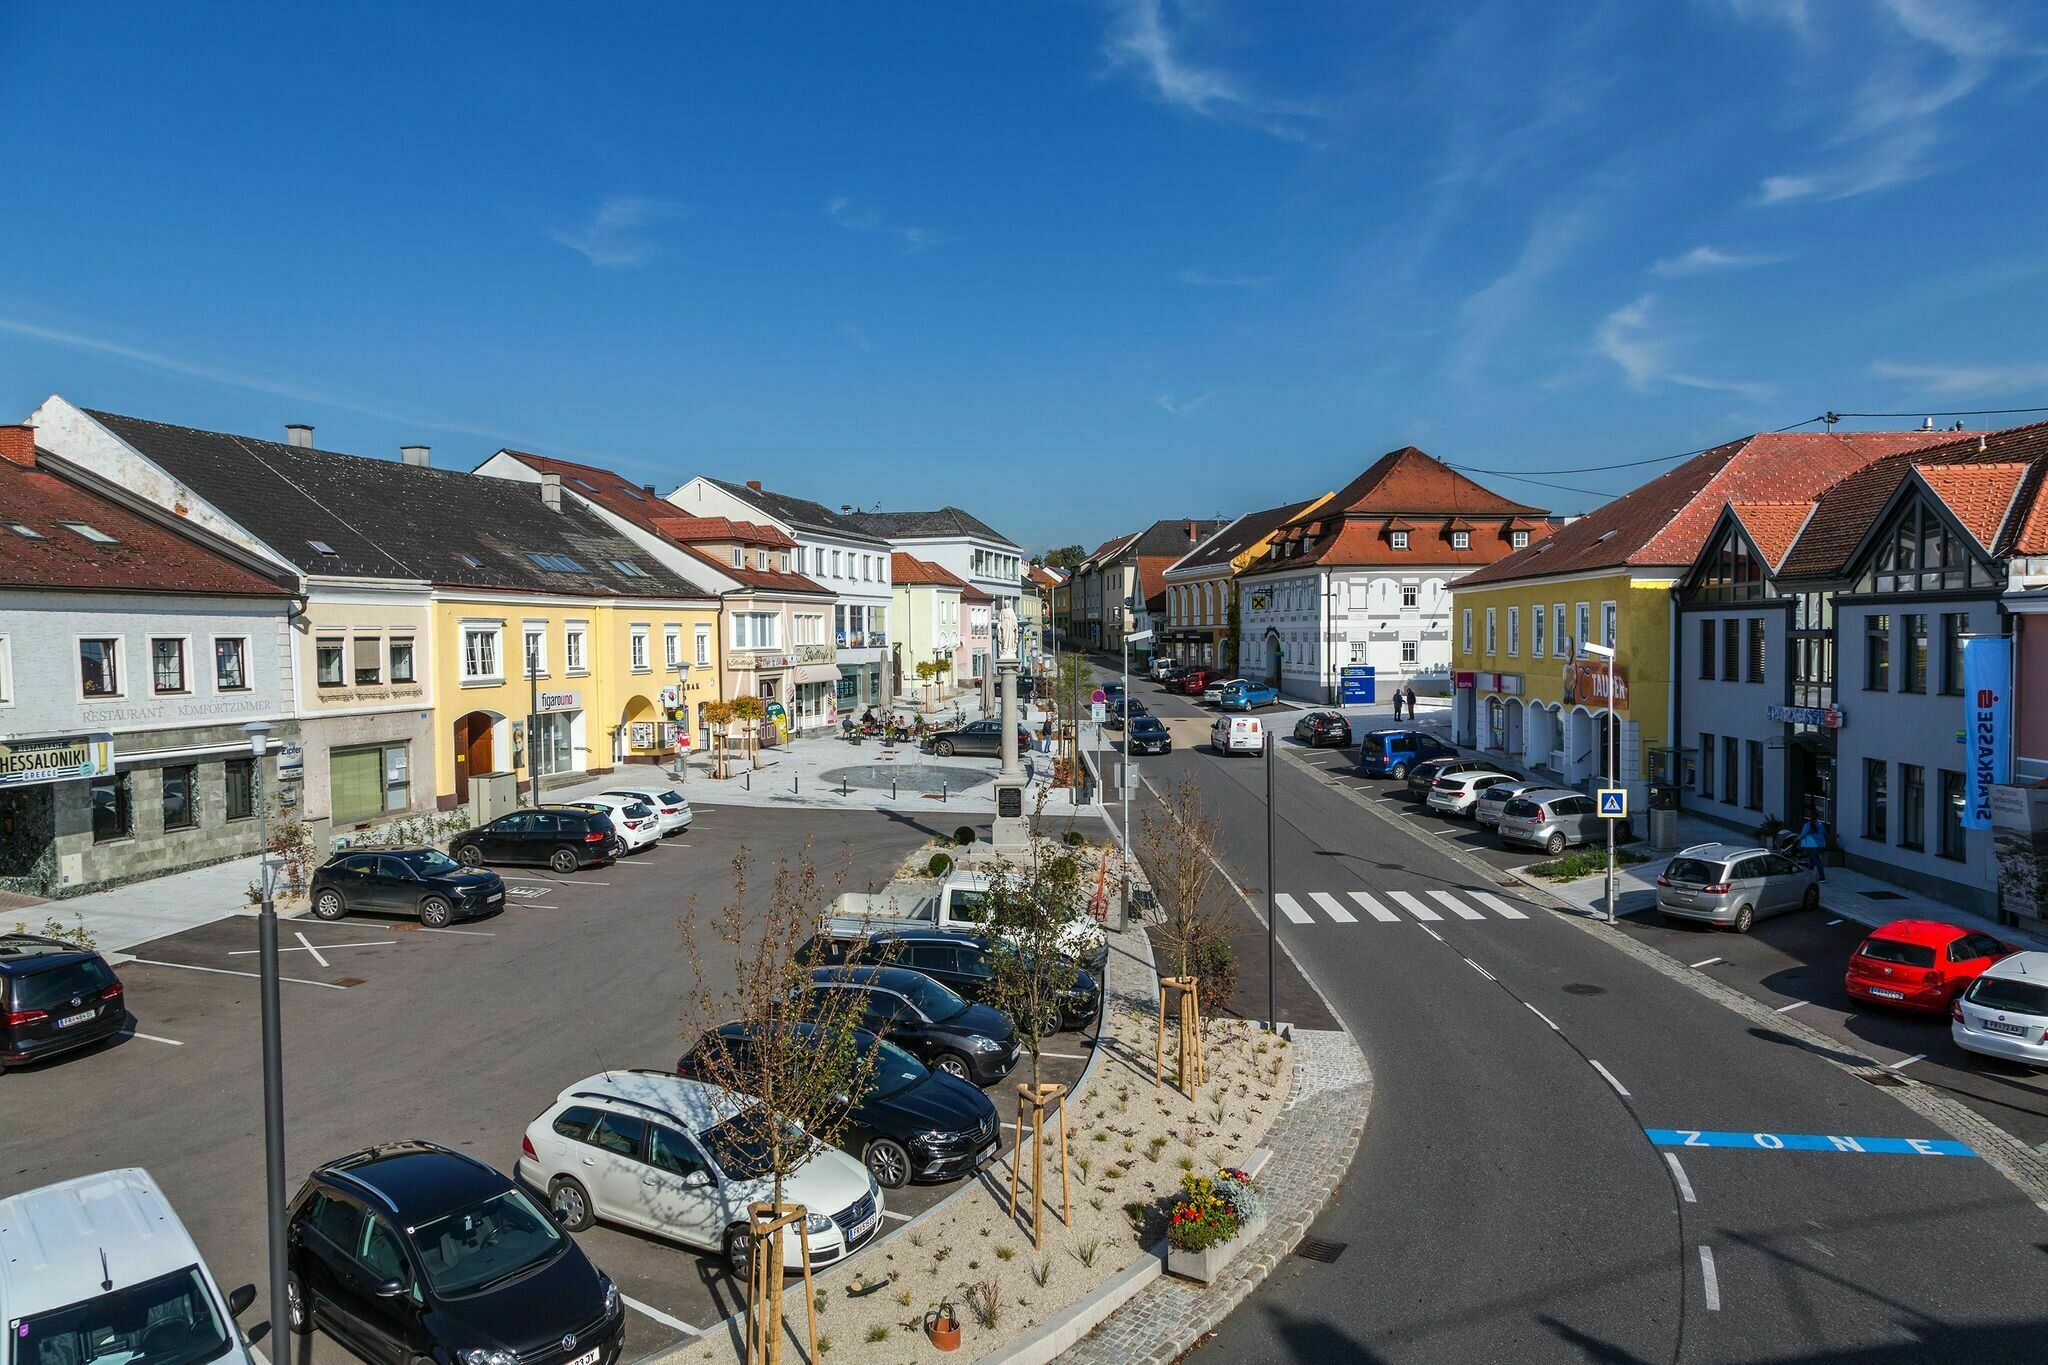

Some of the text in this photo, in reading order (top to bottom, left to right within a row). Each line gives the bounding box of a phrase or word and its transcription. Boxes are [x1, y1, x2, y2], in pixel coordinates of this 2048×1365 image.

[1591, 673, 1626, 699] TAUER
[82, 699, 272, 723] RESTAURANT KOMFORTZIMMER
[18, 742, 64, 753] RESTAURANT
[281, 746, 302, 756] Zipfer
[0, 749, 86, 773] HESSALONIKI
[24, 769, 58, 780] GREECE
[1675, 1129, 1945, 1156] ZONE
